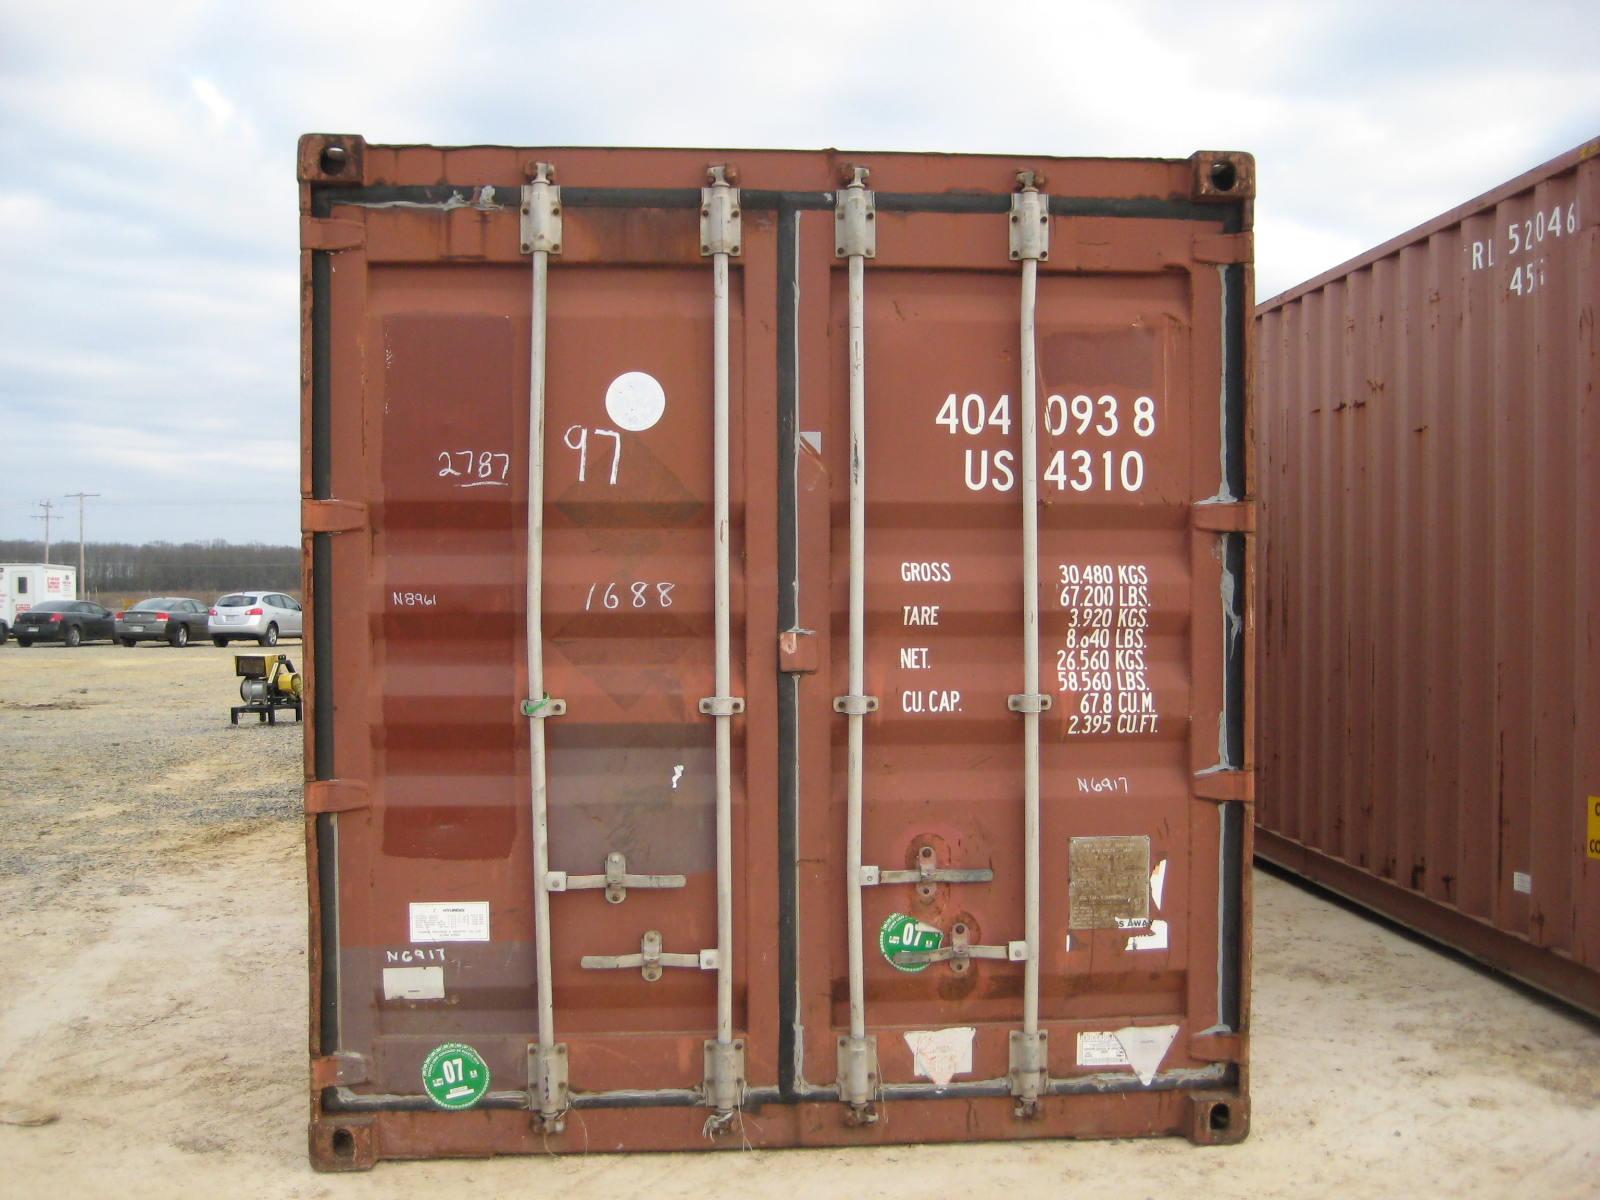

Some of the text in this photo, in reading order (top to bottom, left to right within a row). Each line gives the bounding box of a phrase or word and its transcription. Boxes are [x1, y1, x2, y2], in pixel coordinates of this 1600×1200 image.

[1508, 202, 1576, 255] 52046
[935, 393, 1155, 437] 404 093 8
[438, 450, 510, 480] 2787
[563, 425, 621, 485] 97
[964, 449, 1144, 492] US 4310
[901, 562, 951, 582] GROSS
[1059, 564, 1149, 585] 30.480 KGS
[585, 581, 675, 611] 1688
[1060, 585, 1151, 607] 67.200 LBS.
[903, 605, 940, 626] TARE
[1117, 608, 1149, 628] KGS.
[1115, 628, 1147, 649] LBS.
[900, 648, 931, 669] NET.
[1056, 650, 1148, 671] 26.560 KGS.
[1058, 671, 1150, 692] 58.560 LBS.
[1080, 692, 1112, 714] 67.8
[1067, 714, 1112, 735] 2.395
[1077, 777, 1129, 793] N6917
[442, 1057, 464, 1084] 07
